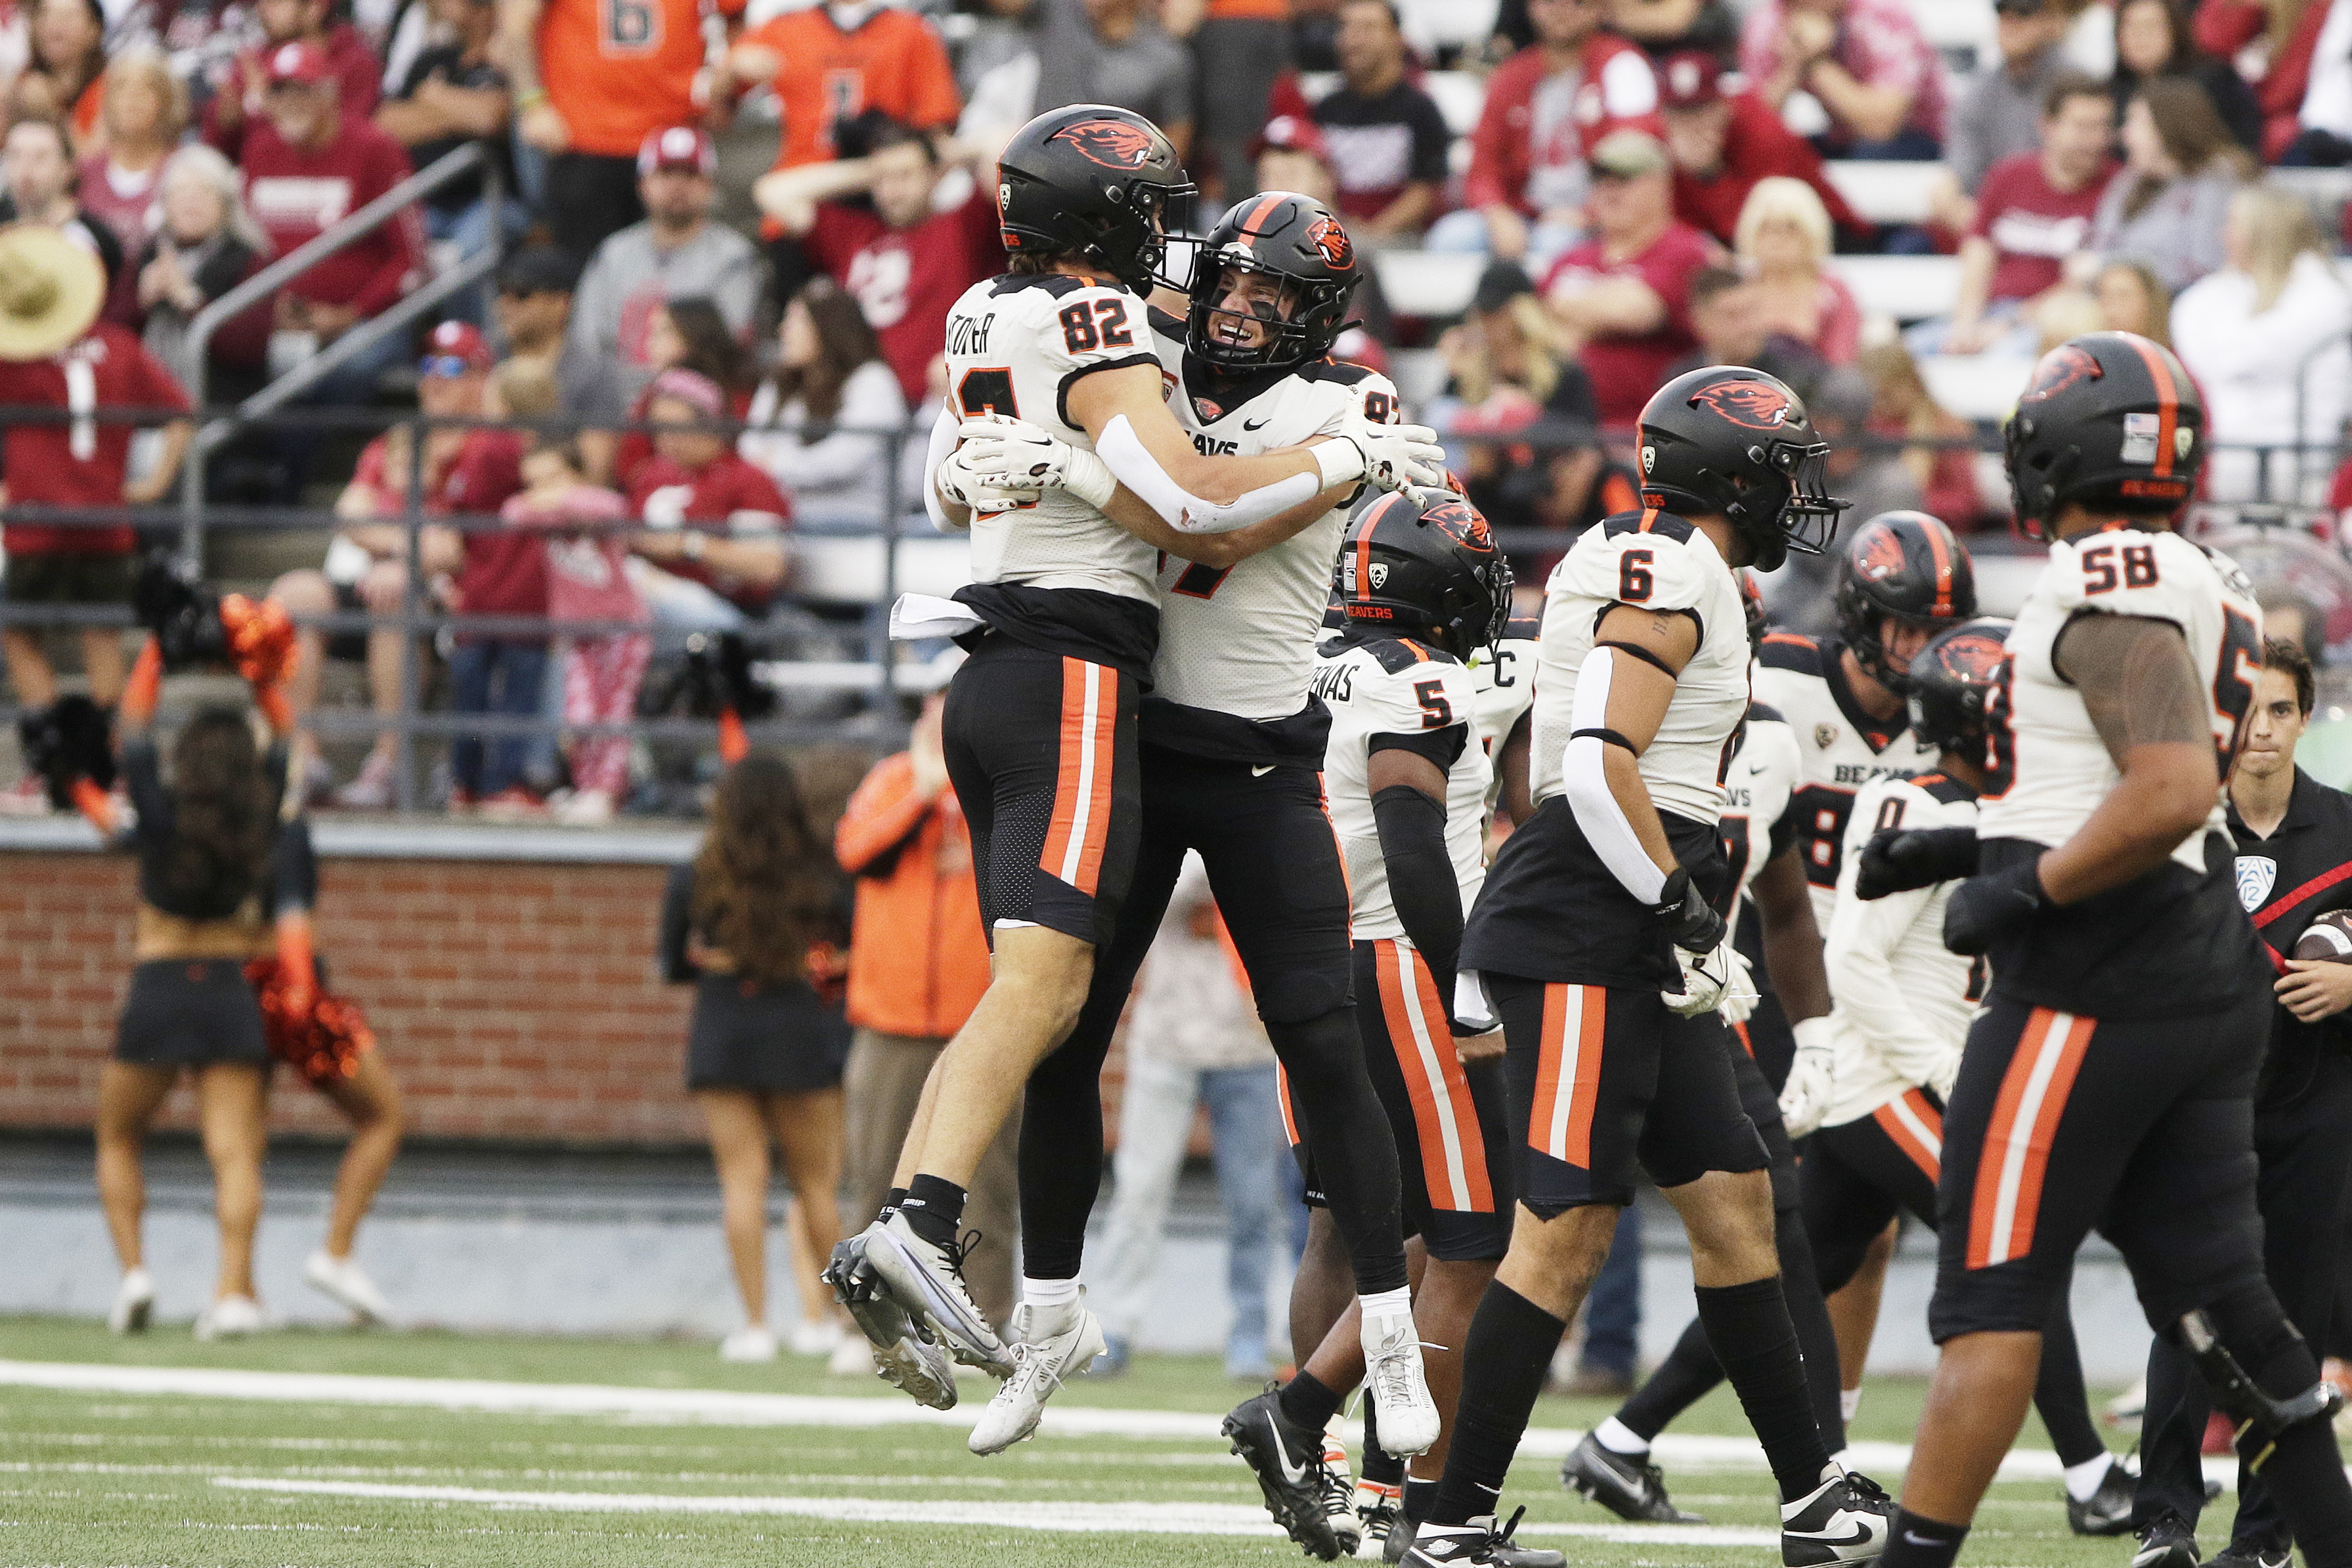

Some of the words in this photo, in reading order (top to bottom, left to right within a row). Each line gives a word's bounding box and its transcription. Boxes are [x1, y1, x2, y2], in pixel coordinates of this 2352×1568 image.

[1058, 299, 1134, 355] 82
[1619, 549, 1654, 602] 6
[2081, 546, 2159, 596] 58
[1494, 651, 1516, 687] C
[1413, 679, 1454, 729] 5
[2243, 886, 2260, 902] 12
